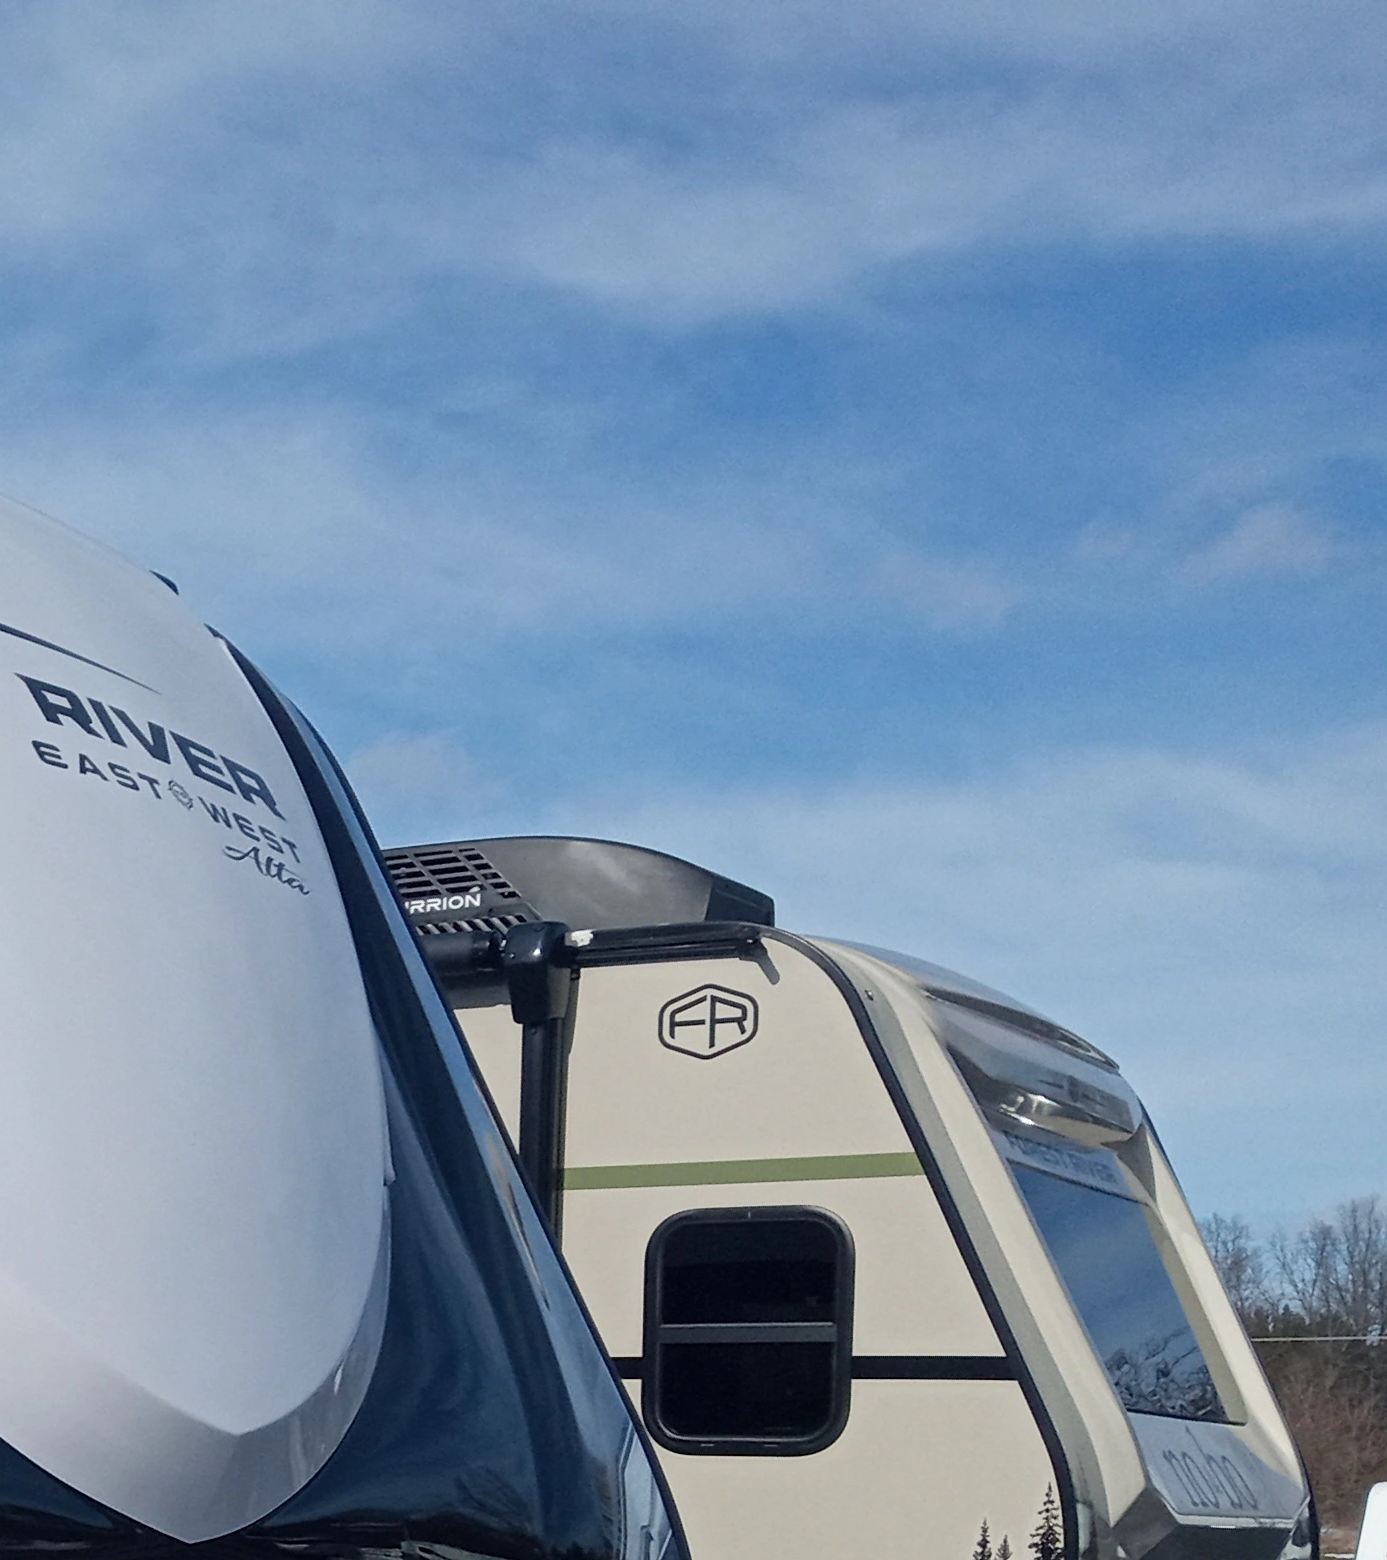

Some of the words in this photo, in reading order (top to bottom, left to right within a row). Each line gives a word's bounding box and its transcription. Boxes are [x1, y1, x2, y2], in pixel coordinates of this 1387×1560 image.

[14, 672, 286, 821] RIVER
[32, 740, 162, 800] EAST
[198, 796, 300, 863] WEST
[222, 845, 310, 896] Alta
